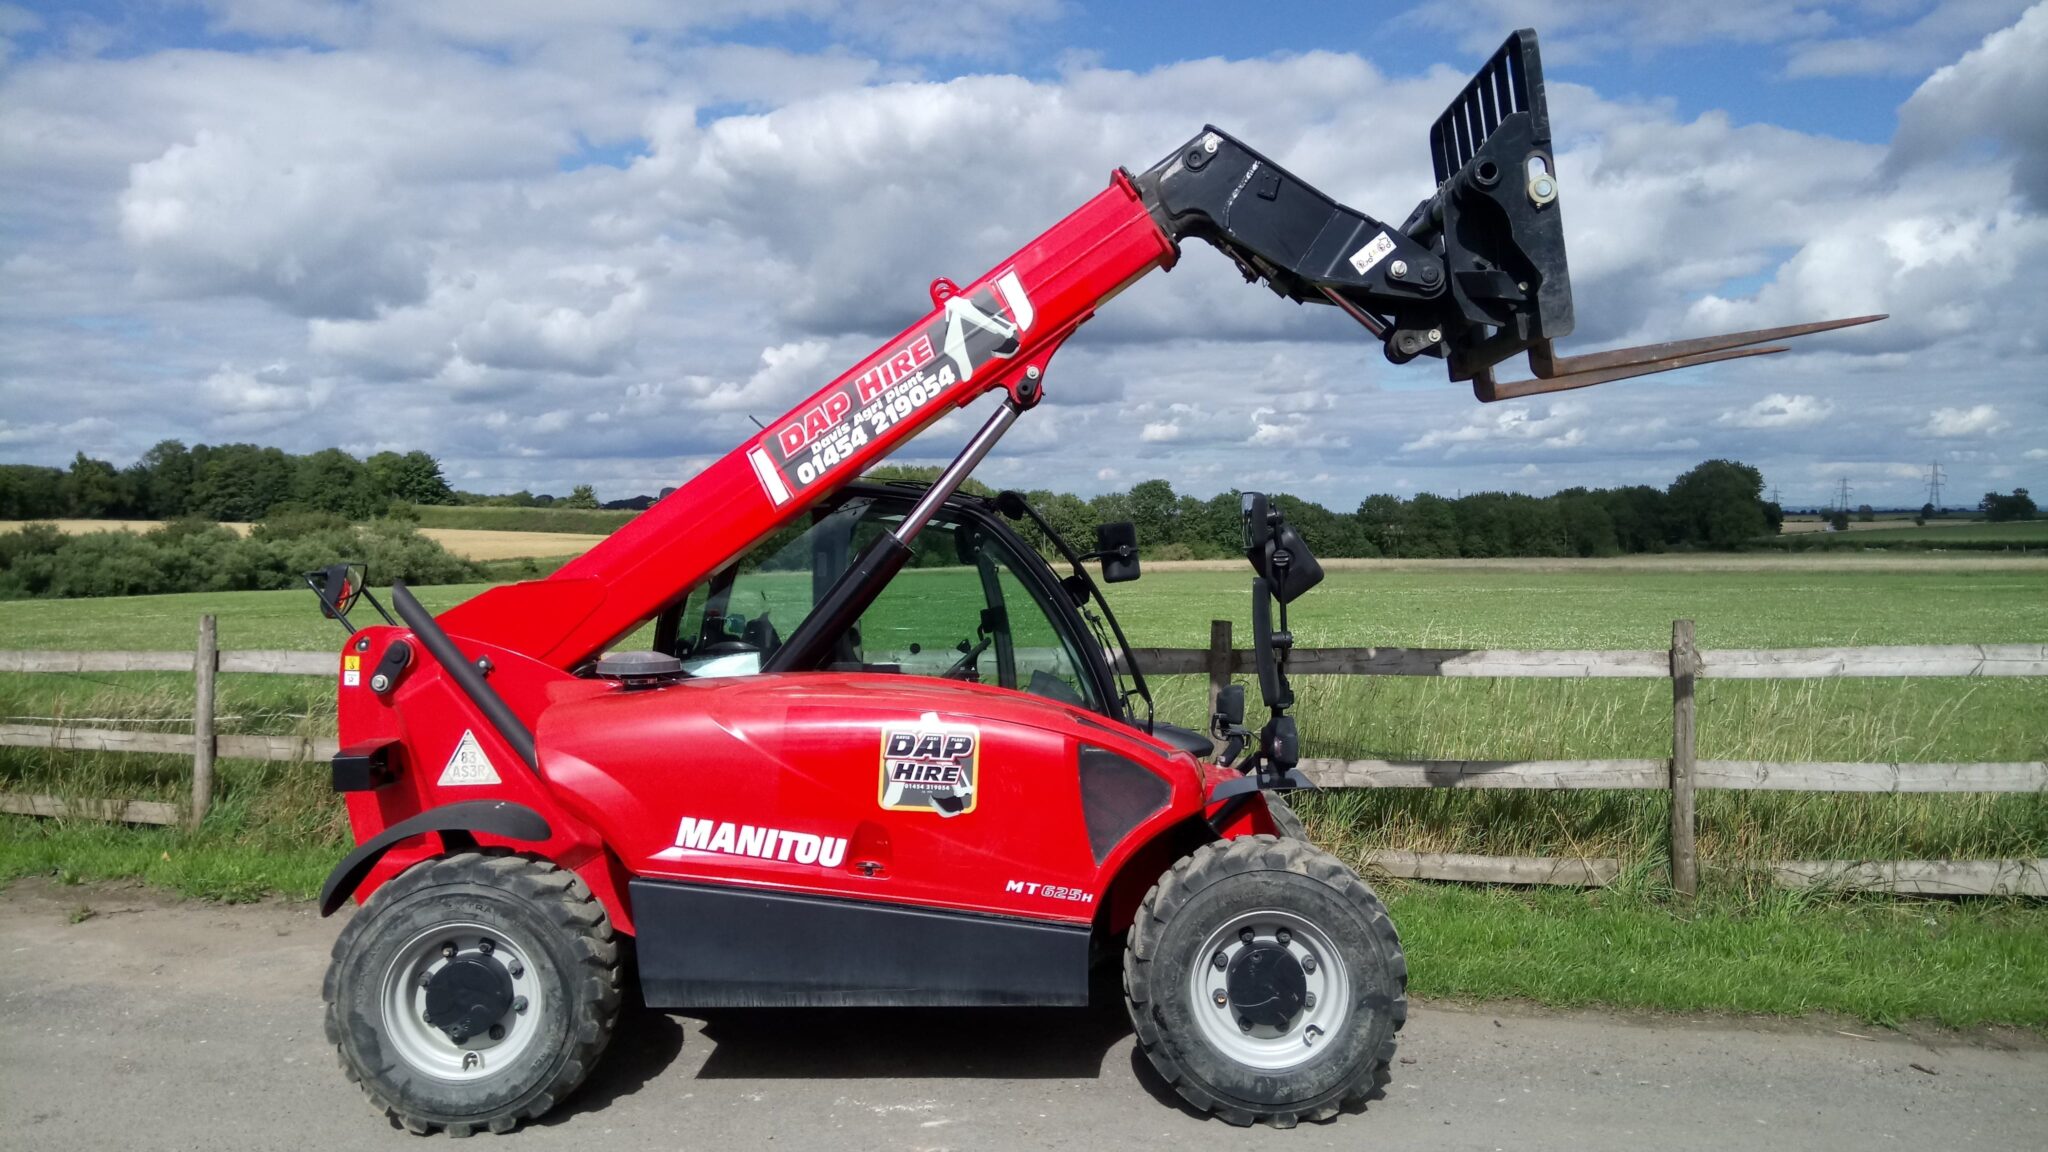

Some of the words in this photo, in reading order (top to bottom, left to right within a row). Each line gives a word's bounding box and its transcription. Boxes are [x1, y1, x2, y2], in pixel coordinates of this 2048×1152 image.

[778, 391, 851, 458] DAP
[855, 334, 935, 405] HIRE
[797, 425, 868, 484] 01454
[871, 364, 956, 435] 219054
[811, 422, 851, 454] Davis
[853, 398, 884, 425] Agri
[885, 371, 925, 403] Plant
[884, 731, 974, 760] DAP
[891, 761, 961, 784] HIRE
[674, 816, 848, 868] MANITOU
